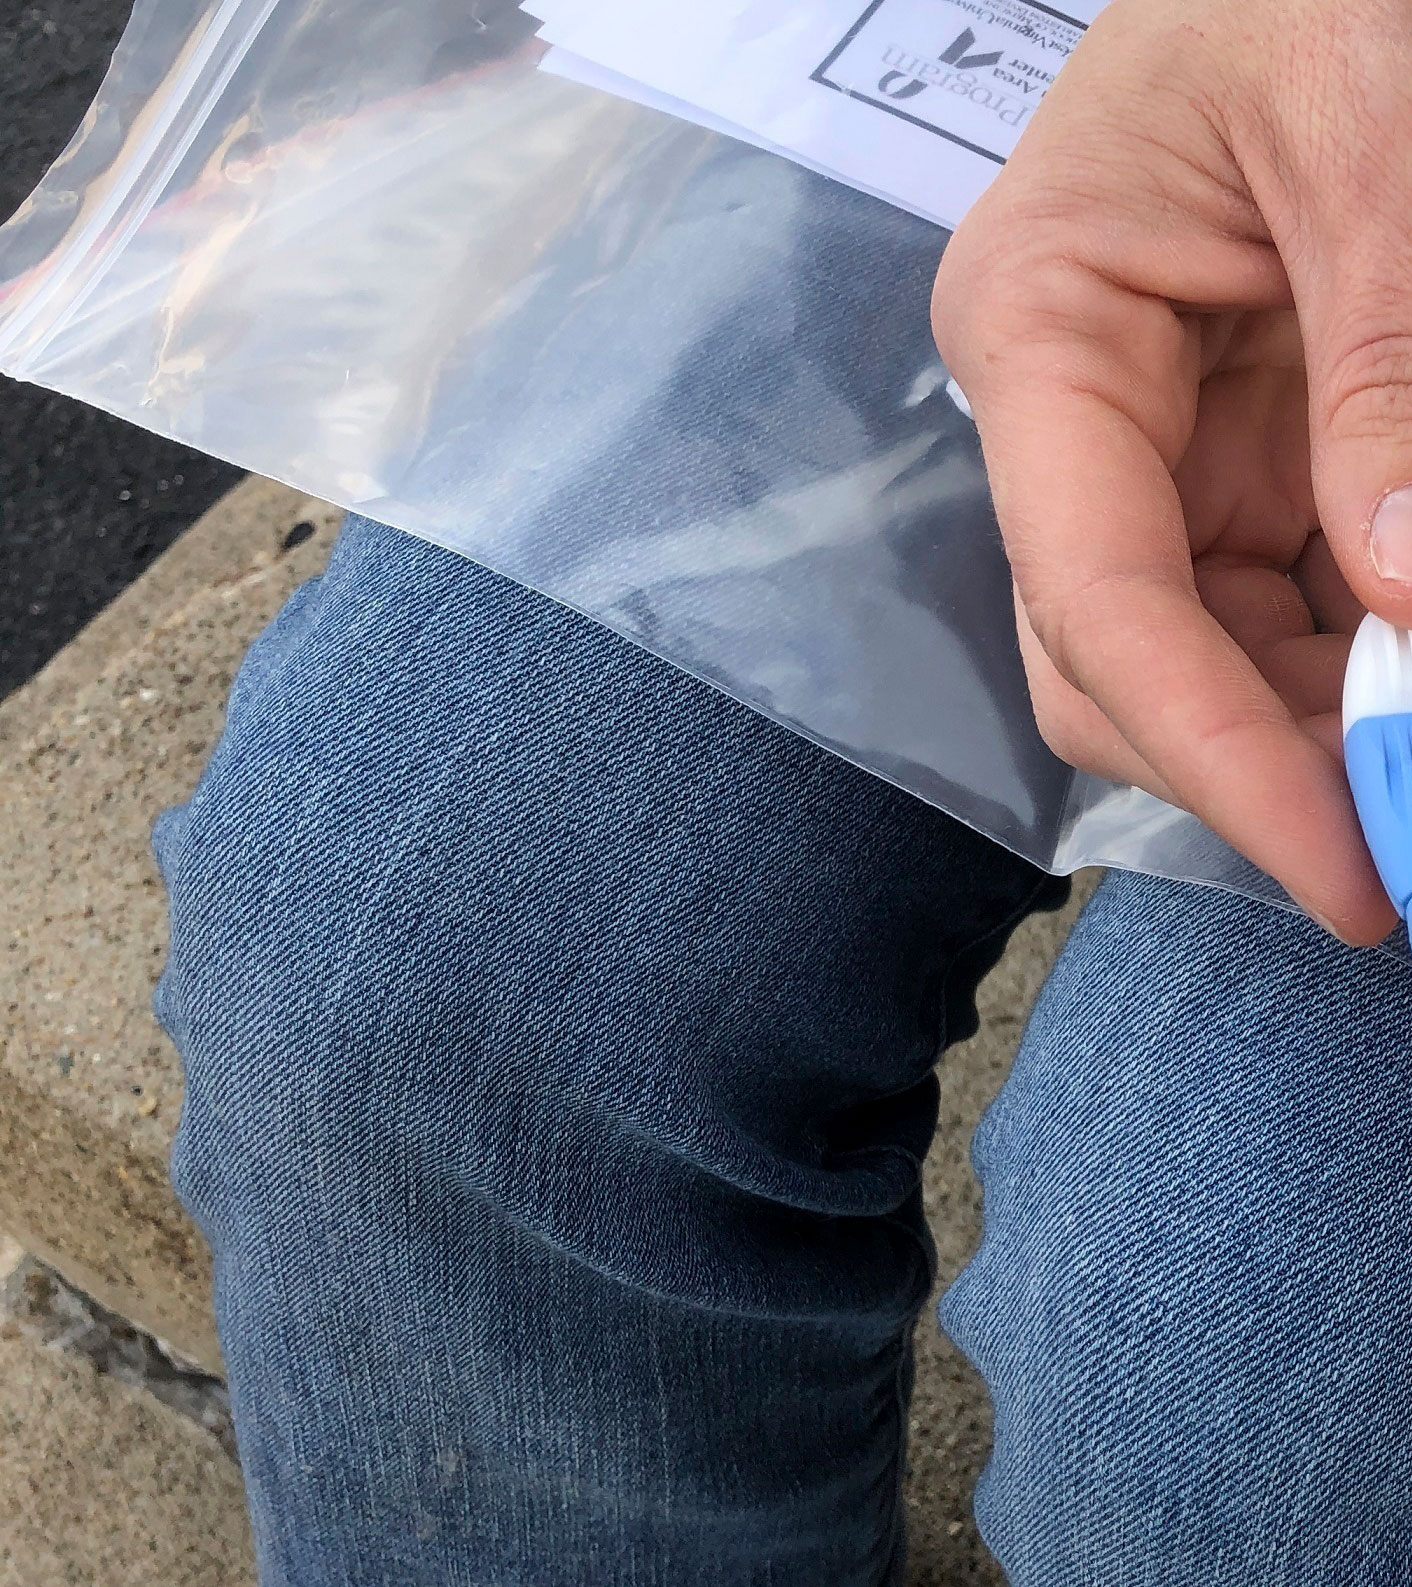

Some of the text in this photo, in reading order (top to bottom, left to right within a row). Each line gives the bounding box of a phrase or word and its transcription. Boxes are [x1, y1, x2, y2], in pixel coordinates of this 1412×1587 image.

[993, 67, 1038, 94] Area
[1008, 60, 1054, 84] enter
[880, 46, 1034, 127] Program
